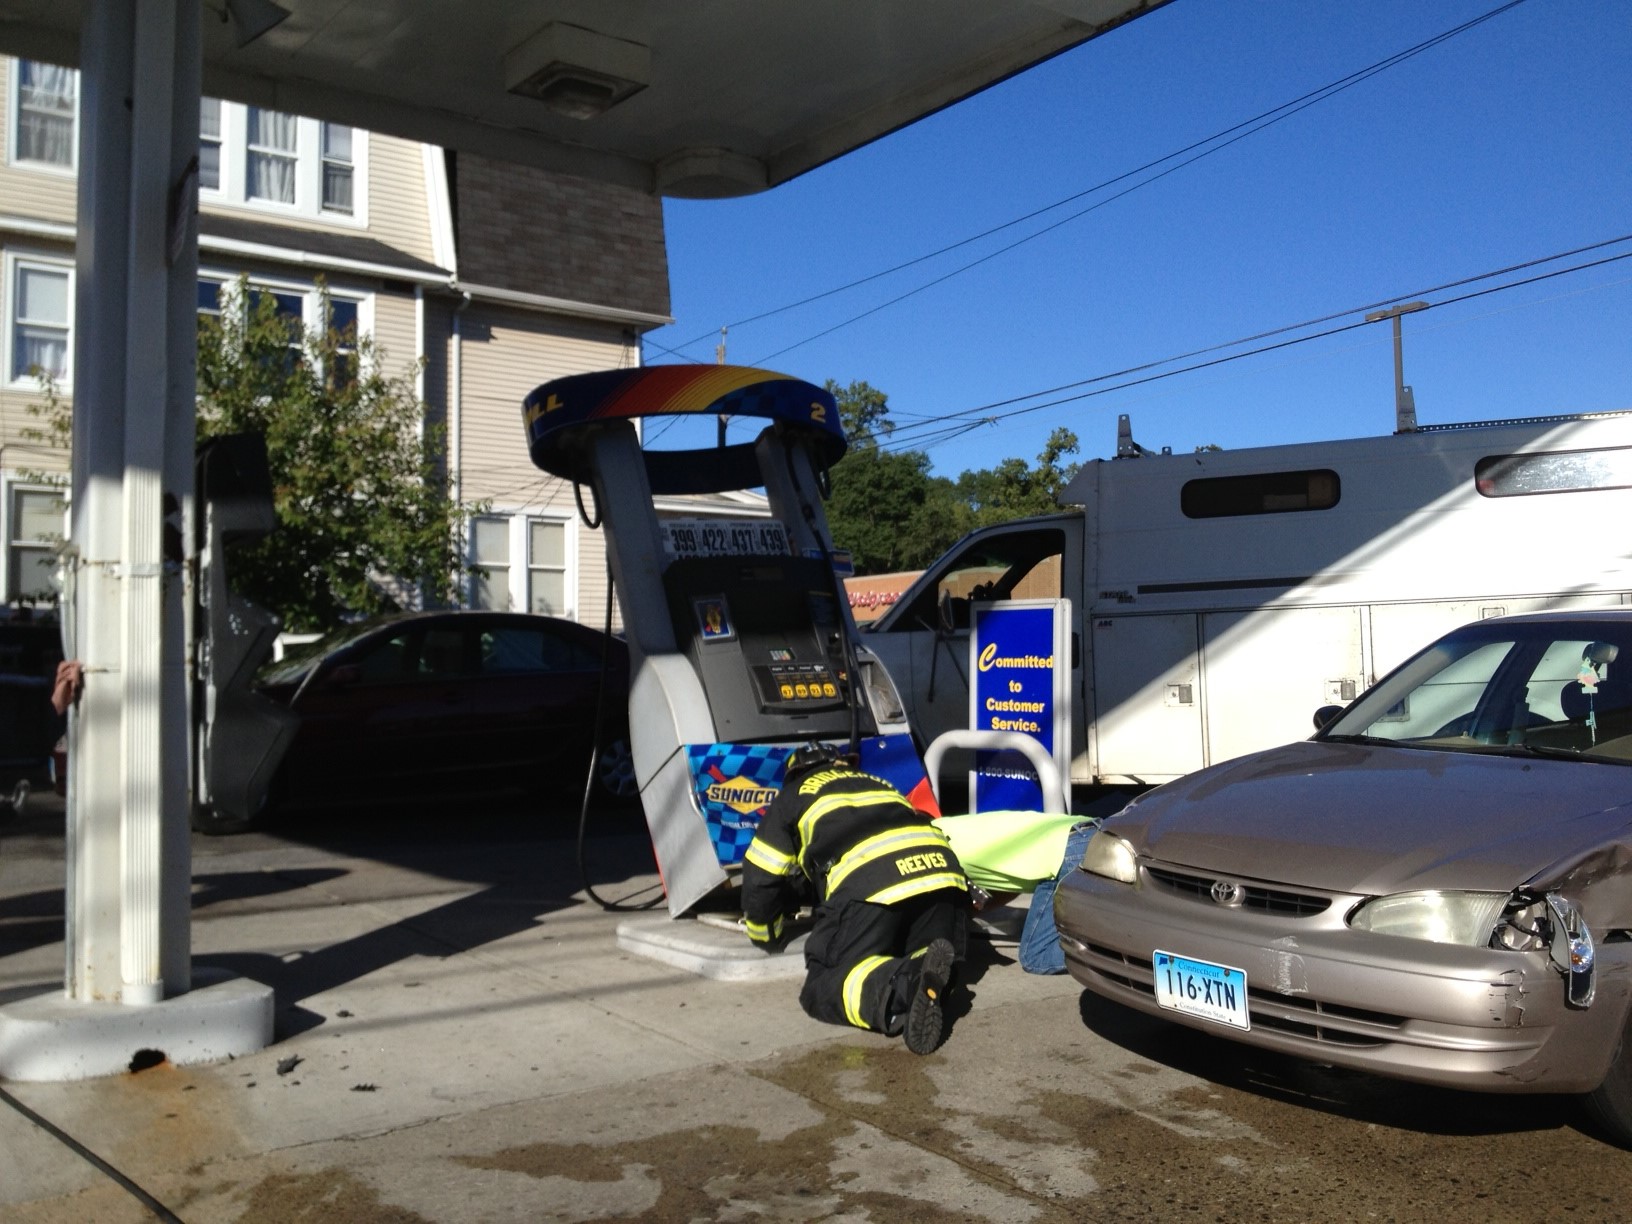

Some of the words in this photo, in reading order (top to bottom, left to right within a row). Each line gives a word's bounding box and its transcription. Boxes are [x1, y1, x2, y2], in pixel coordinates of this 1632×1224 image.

[810, 401, 826, 424] 2
[670, 528, 697, 552] 399
[702, 528, 727, 551] 422
[731, 529, 754, 553] 437
[760, 528, 784, 552] 439
[847, 590, 903, 611] Walgree
[979, 643, 1054, 672] Committed
[1009, 680, 1022, 693] to
[986, 697, 1045, 713] Customer
[991, 716, 1041, 732] Service.
[979, 766, 1038, 781] 1-800-SUNOC
[711, 787, 776, 803] SUNOCO
[895, 852, 947, 876] REEVES
[1178, 961, 1220, 978] Connecticut
[1179, 1001, 1211, 1016] Constitution
[1213, 1010, 1227, 1020] State
